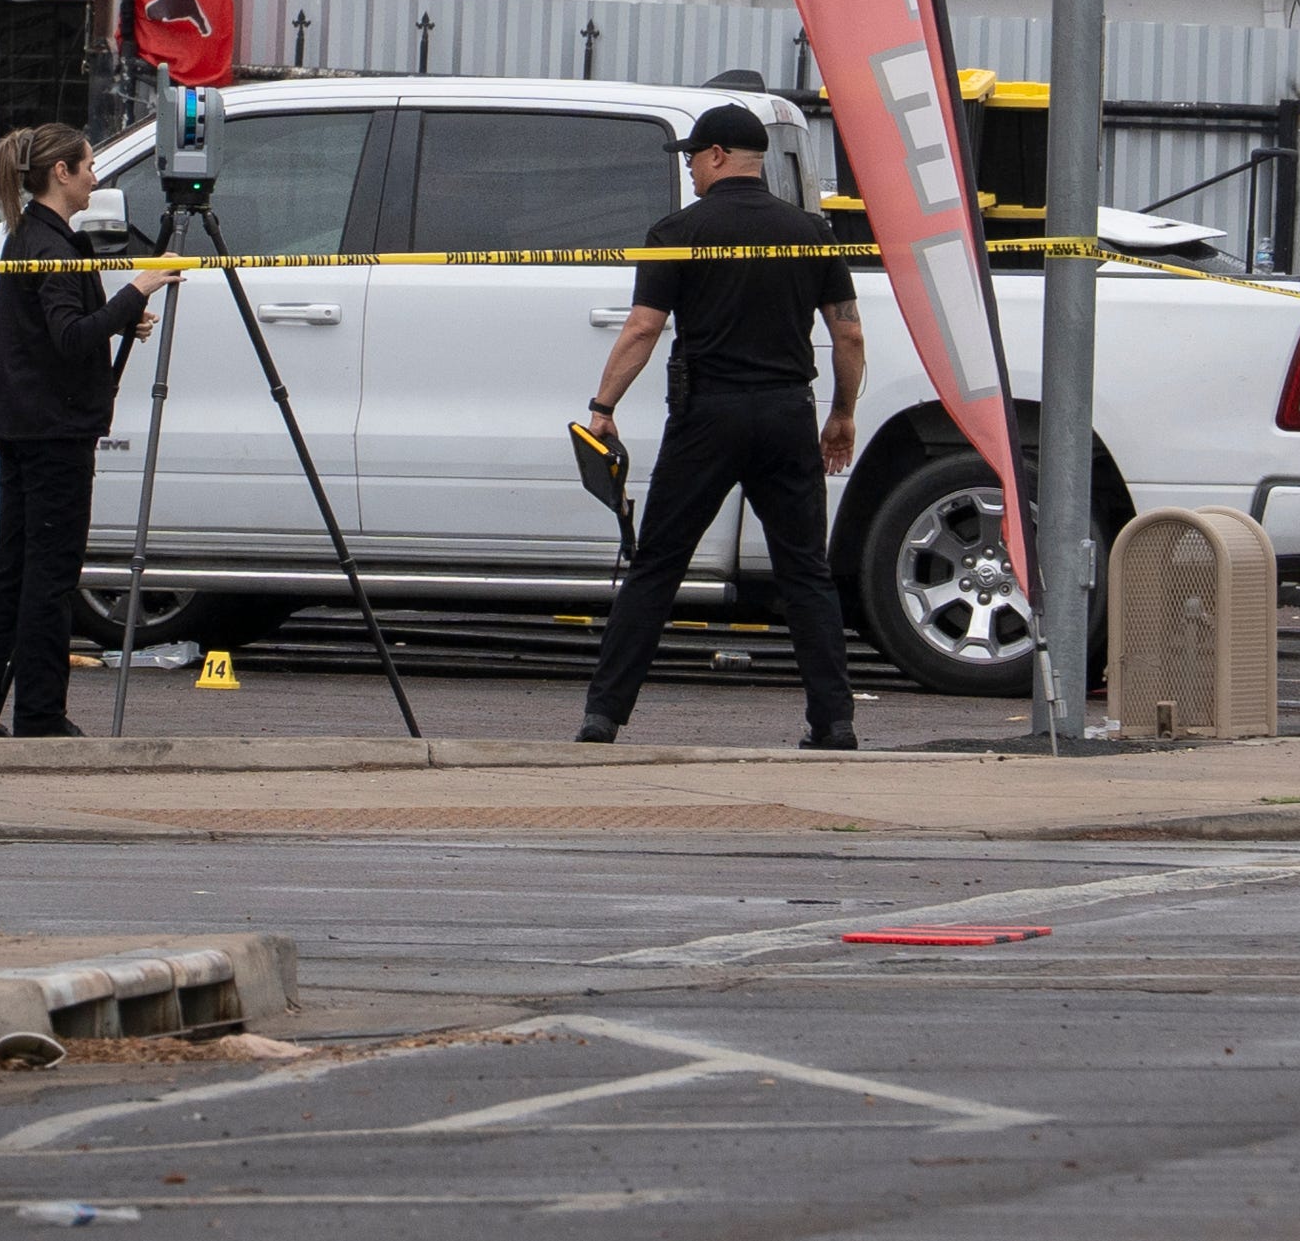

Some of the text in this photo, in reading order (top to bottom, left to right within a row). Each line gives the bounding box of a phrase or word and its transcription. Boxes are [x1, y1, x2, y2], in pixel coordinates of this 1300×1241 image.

[446, 249, 625, 264] POLICE LINE DO NOT CROSS
[691, 244, 873, 259] POLICE LINE DO NOT CROSS
[4, 260, 33, 272] LINE
[37, 260, 56, 272] DO
[61, 259, 85, 271] NOT
[91, 258, 134, 271] CROSS
[200, 253, 380, 268] POLICE LINE DO NOT CROSS
[206, 659, 226, 678] 14
